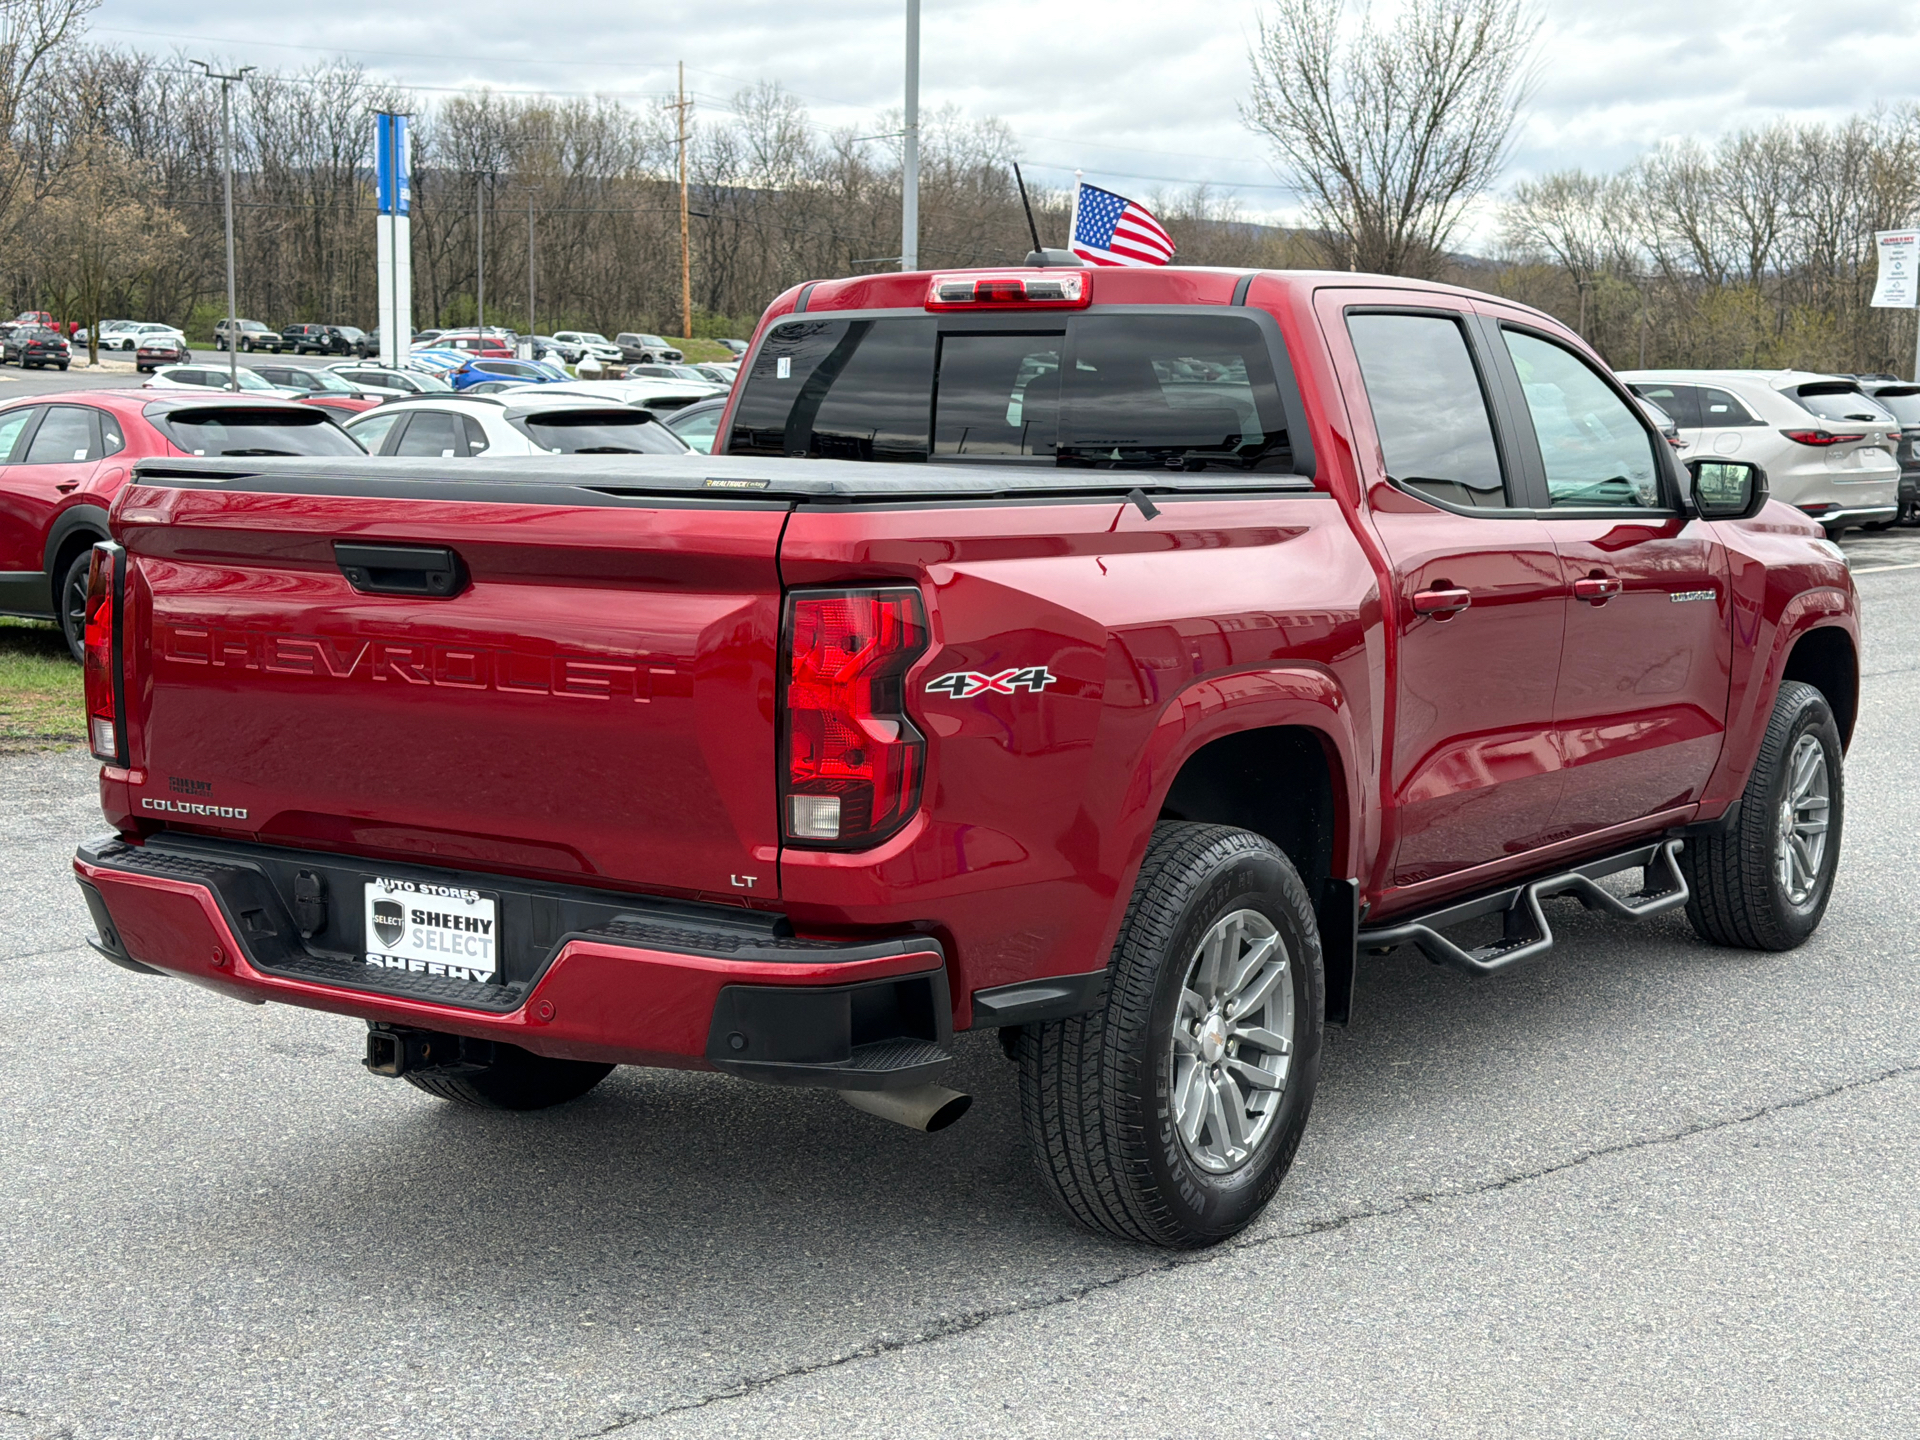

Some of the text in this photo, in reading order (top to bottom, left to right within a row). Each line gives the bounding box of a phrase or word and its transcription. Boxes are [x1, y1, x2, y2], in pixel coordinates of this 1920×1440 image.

[163, 623, 677, 704] CHEVROLET
[142, 797, 248, 820] COLORADO
[375, 877, 480, 901] AUTO STORES
[730, 874, 758, 888] LT
[373, 914, 403, 927] SELECT
[411, 908, 493, 936] SHEEHY
[412, 927, 493, 960] SELECT
[1155, 1052, 1206, 1216] WRANGLER
